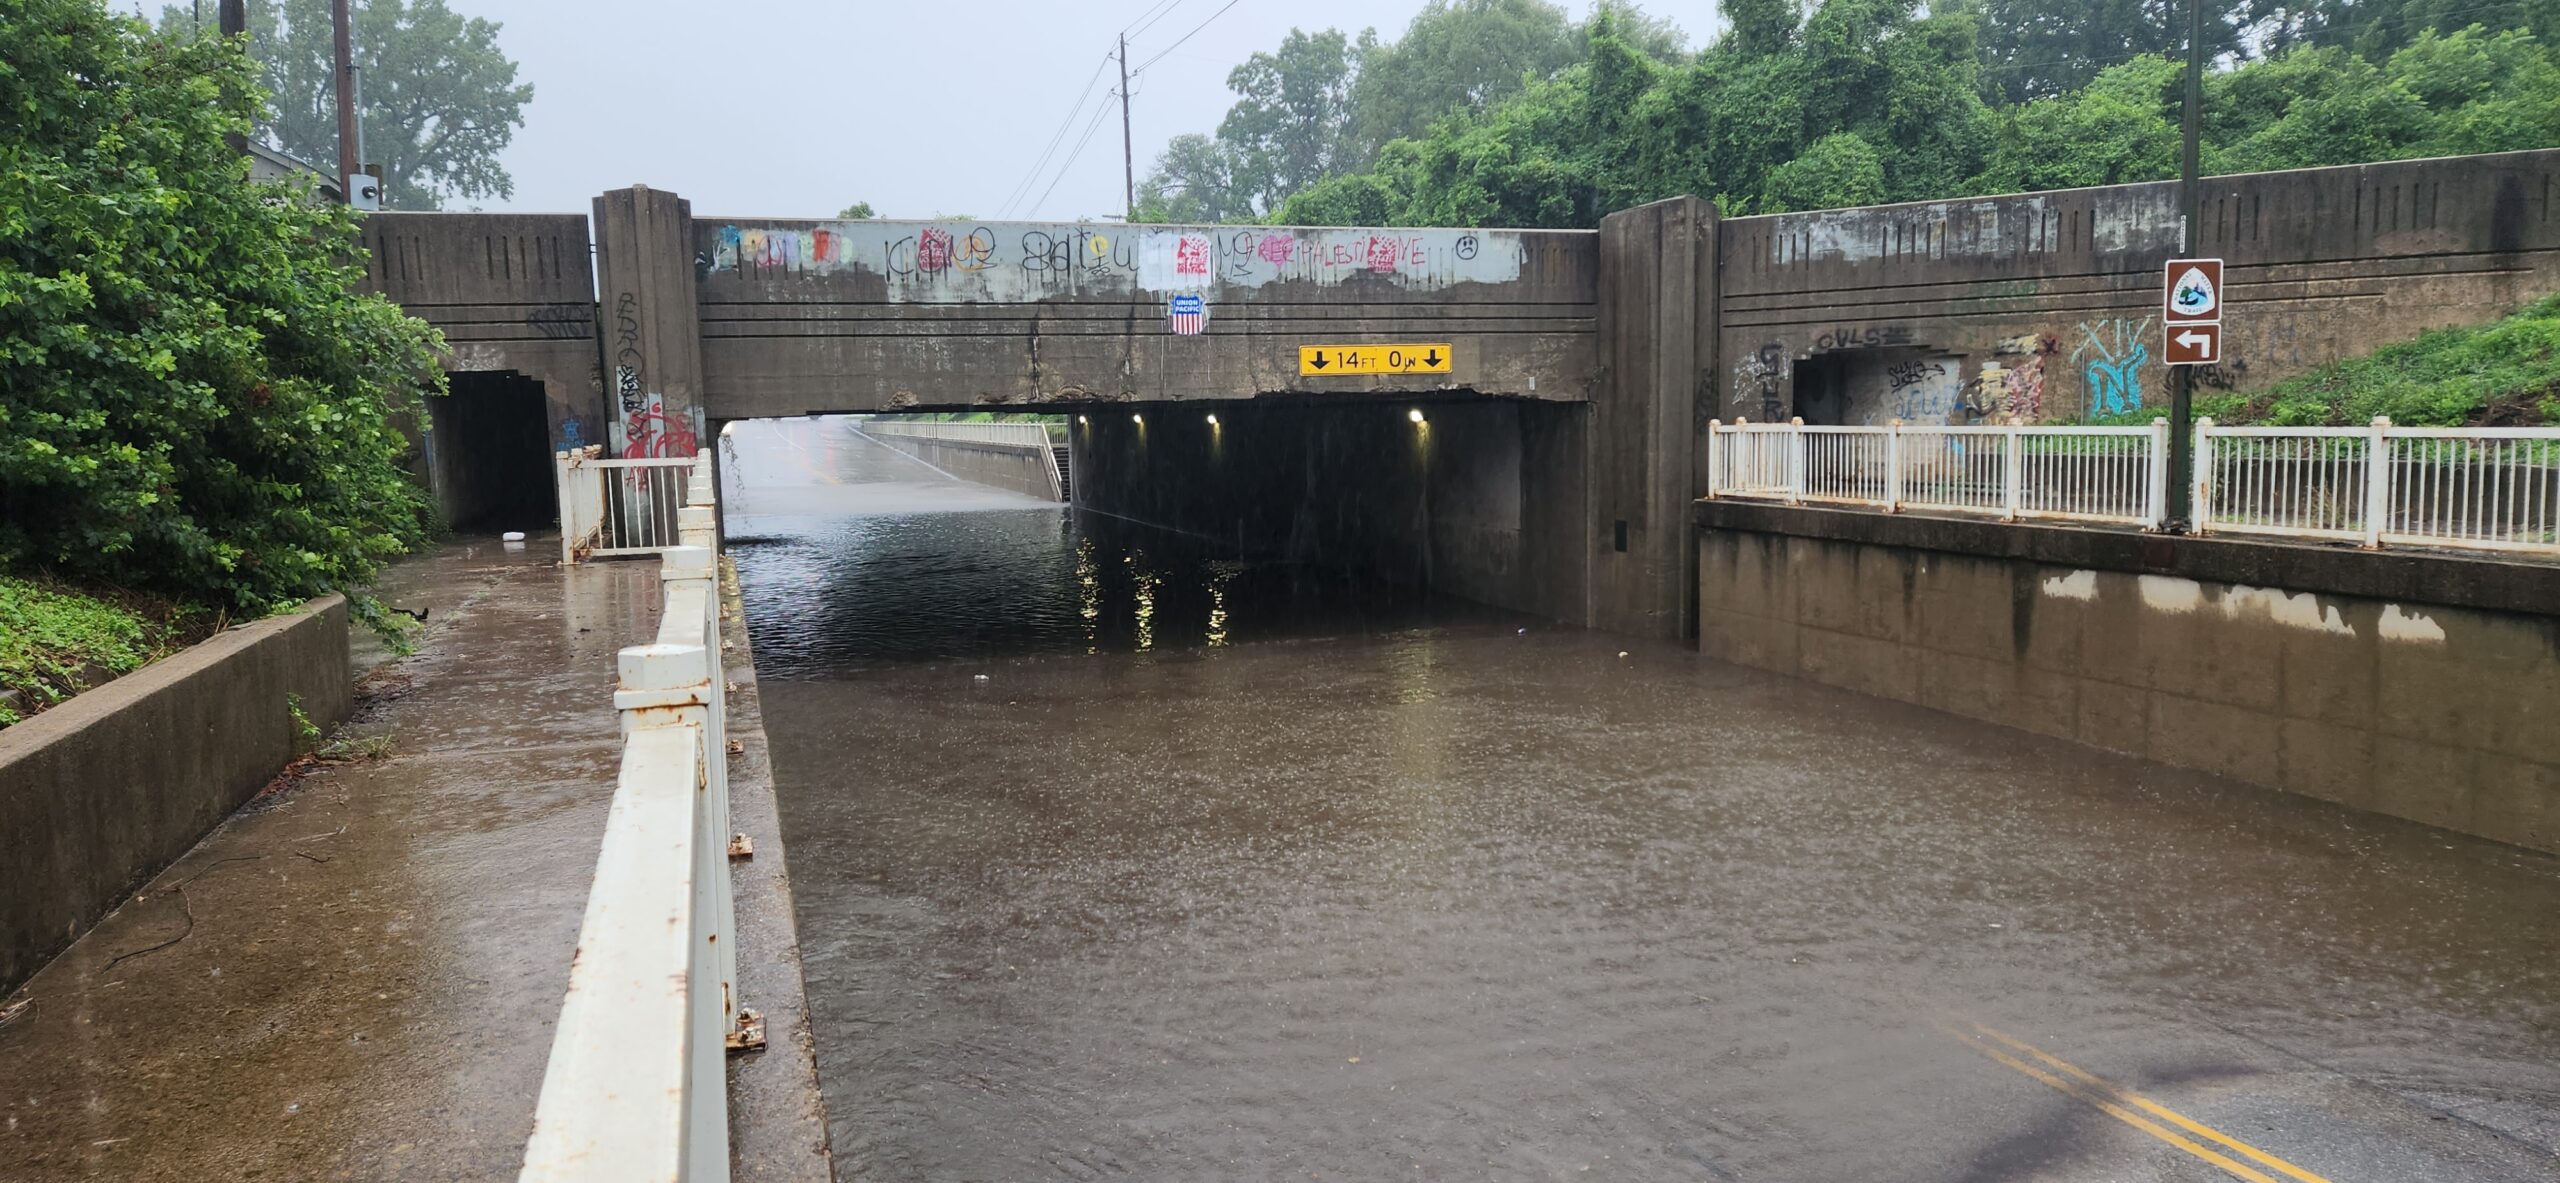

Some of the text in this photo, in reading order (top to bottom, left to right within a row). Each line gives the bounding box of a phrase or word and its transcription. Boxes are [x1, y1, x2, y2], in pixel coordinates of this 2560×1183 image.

[1337, 351, 1359, 368] 14
[1361, 357, 1377, 368] FT
[1389, 350, 1401, 367] 0
